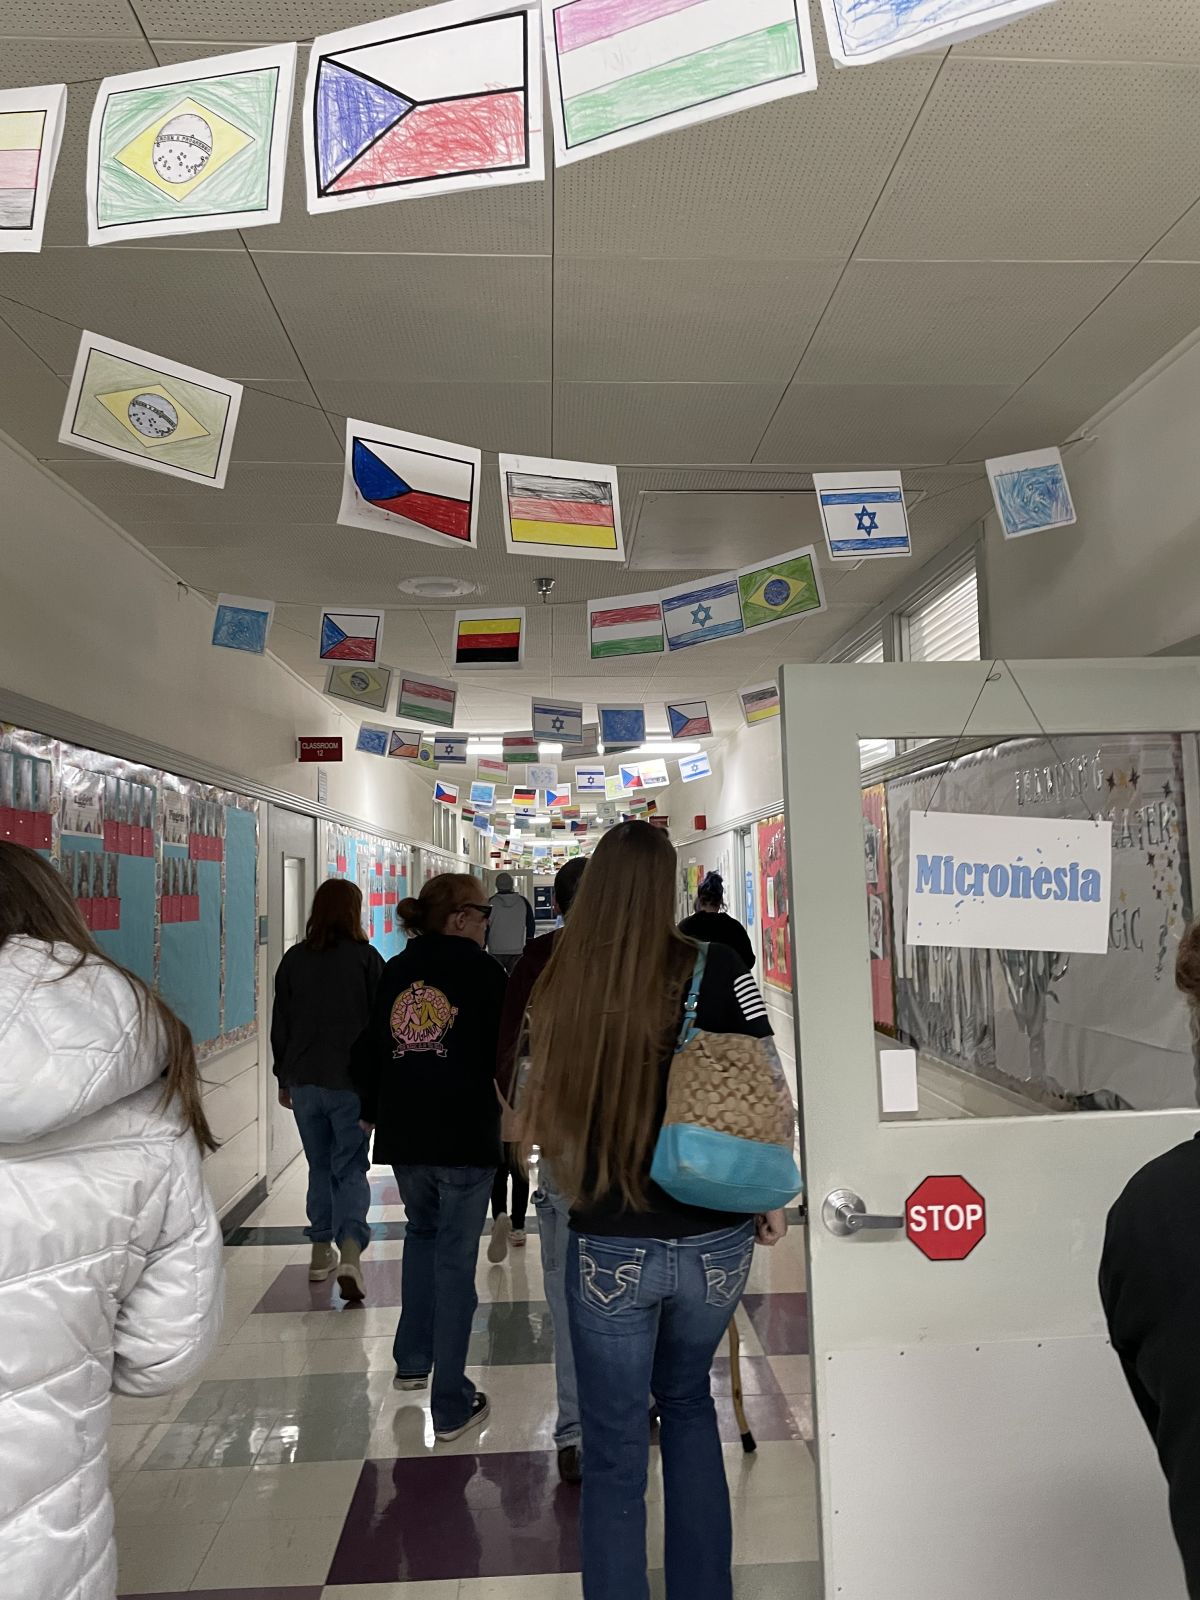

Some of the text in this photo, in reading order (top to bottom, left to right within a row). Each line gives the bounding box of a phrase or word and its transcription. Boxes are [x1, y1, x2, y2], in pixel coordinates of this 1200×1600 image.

[301, 742, 339, 750] CLASSROOM
[1015, 750, 1104, 806] LEARNING
[915, 854, 1101, 902] Micronesia
[1108, 906, 1144, 952] GIC
[910, 1204, 983, 1232] STOP
